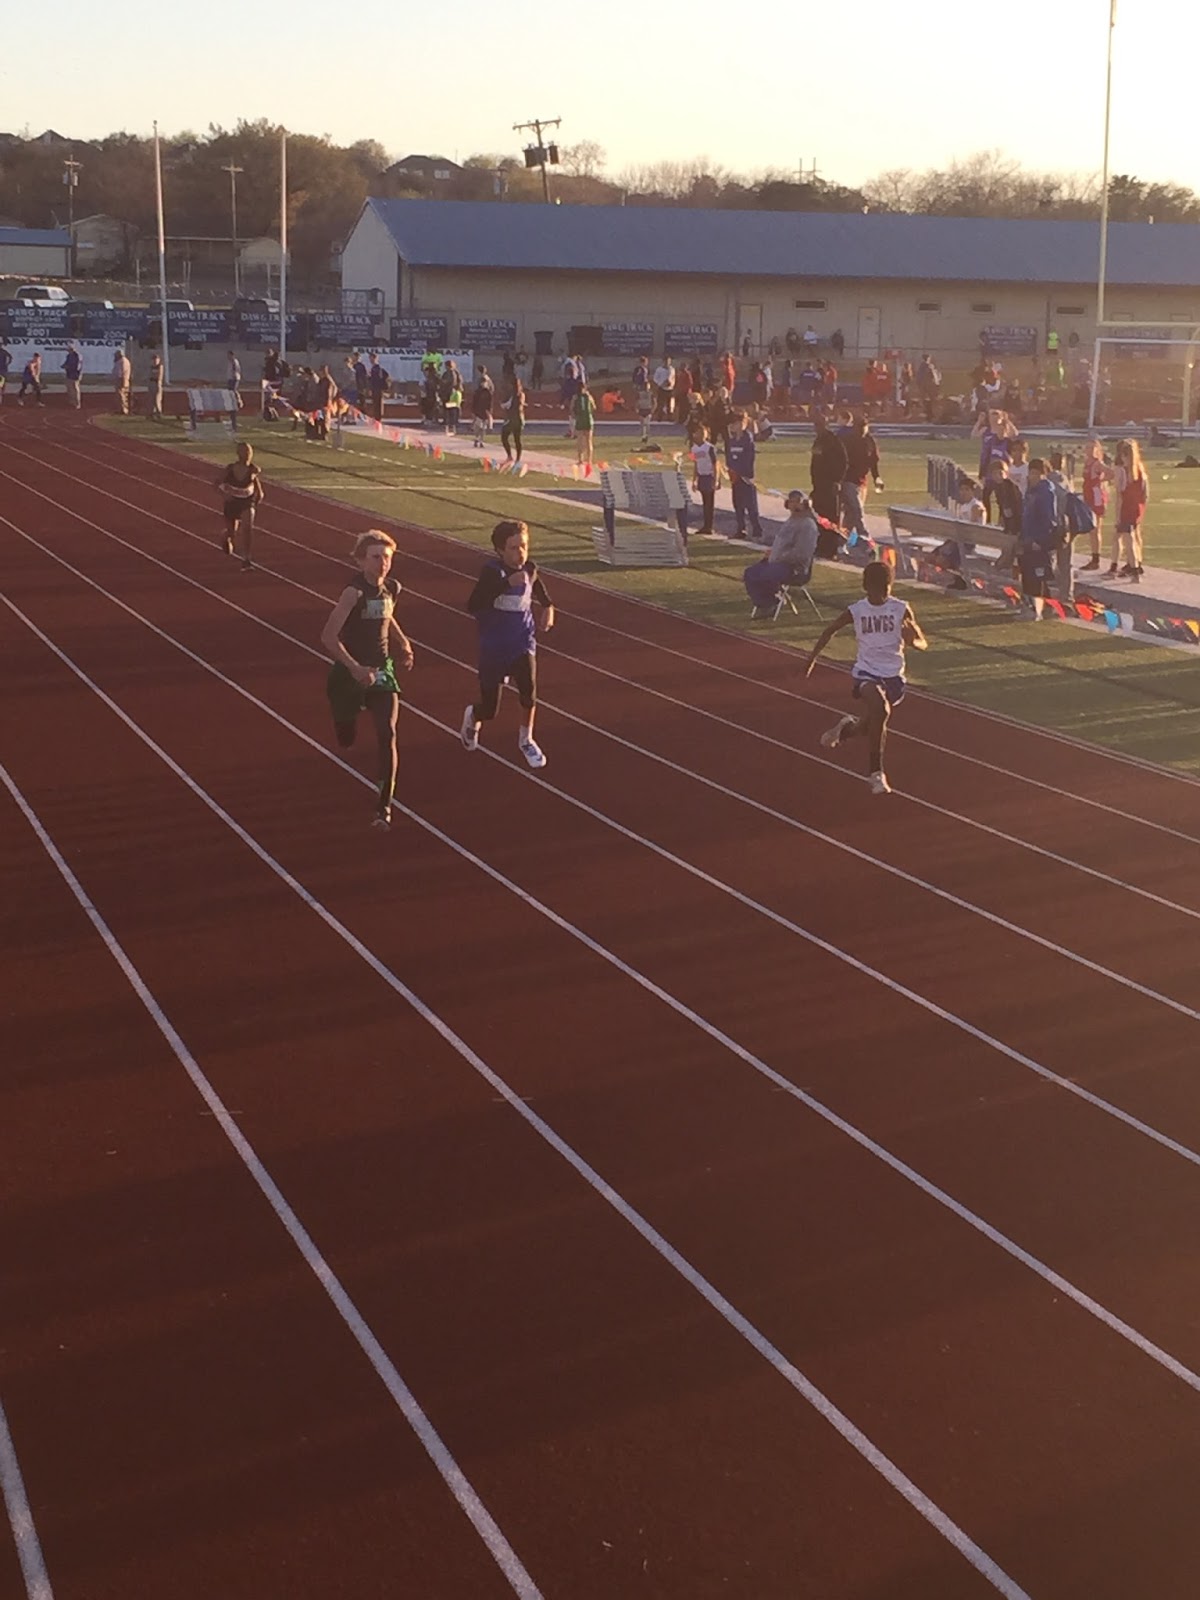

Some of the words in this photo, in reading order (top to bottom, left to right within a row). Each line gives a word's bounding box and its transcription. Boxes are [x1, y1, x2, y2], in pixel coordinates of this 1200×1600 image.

[8, 308, 35, 317] DAWG
[38, 308, 68, 317] TRACK
[86, 310, 112, 319] DAWG
[115, 310, 143, 319] TRACK
[168, 310, 195, 320] DAWG
[197, 311, 226, 321] TRACK
[240, 312, 266, 321] DAWG
[268, 313, 297, 323] TRCK
[315, 313, 342, 323] DAWG
[343, 315, 372, 325] TRACK
[391, 319, 417, 327] DAWG
[417, 319, 446, 328] TRACK
[460, 319, 488, 328] DAWG
[490, 319, 516, 329] TRACK
[26, 328, 50, 337] 2001
[2, 338, 30, 346] ADY
[34, 338, 74, 346] DAWG
[78, 339, 122, 347] TRACK
[357, 347, 424, 355] BULLDAWG
[861, 615, 895, 634] DAWGS
